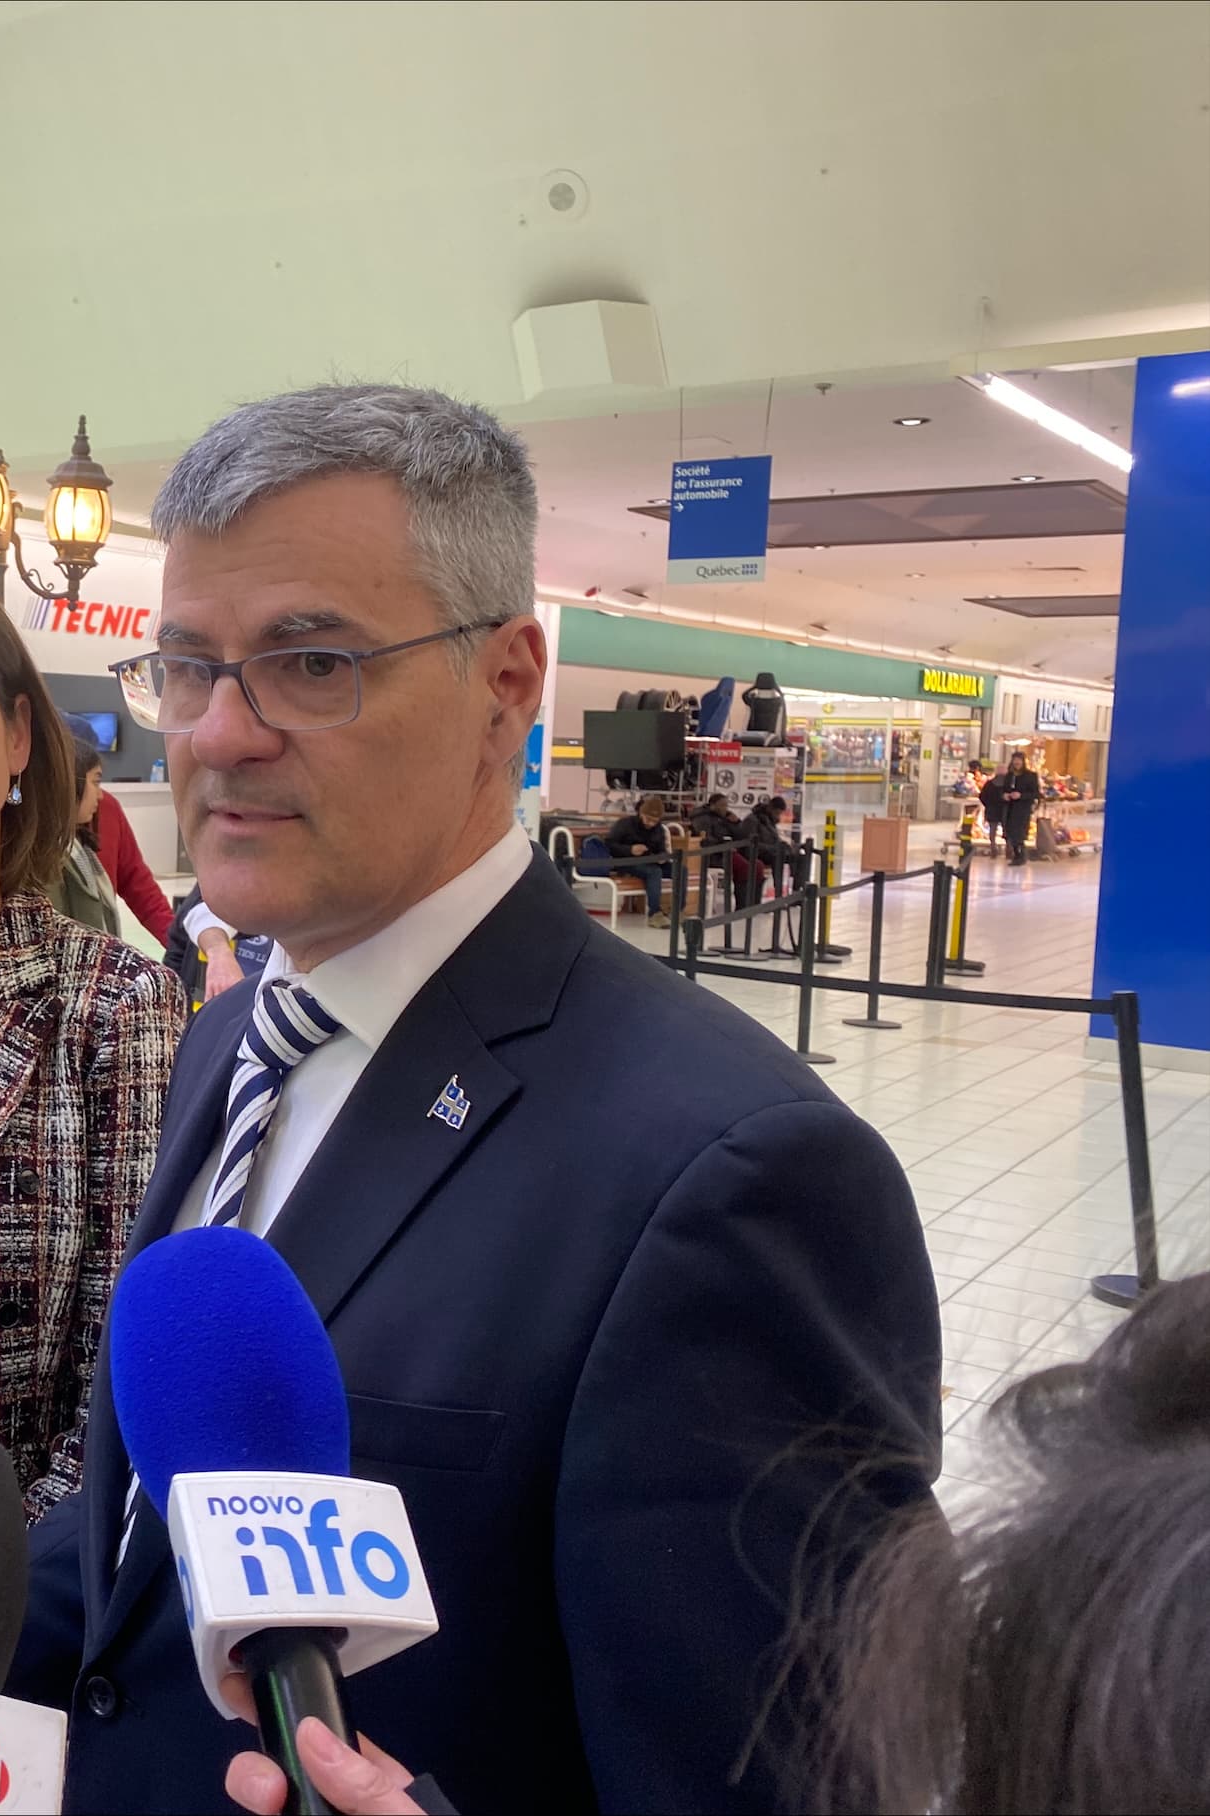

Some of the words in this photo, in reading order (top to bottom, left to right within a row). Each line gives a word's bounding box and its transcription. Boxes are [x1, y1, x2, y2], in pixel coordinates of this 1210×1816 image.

[675, 465, 710, 477] Société
[674, 480, 687, 489] de
[689, 478, 743, 489] l'assurance
[673, 489, 730, 501] automobile
[696, 565, 741, 578] Québec
[51, 597, 151, 639] TECNIC
[923, 668, 977, 697] DOLLARAMA
[207, 1495, 304, 1516] noovo
[236, 1499, 410, 1600] info
